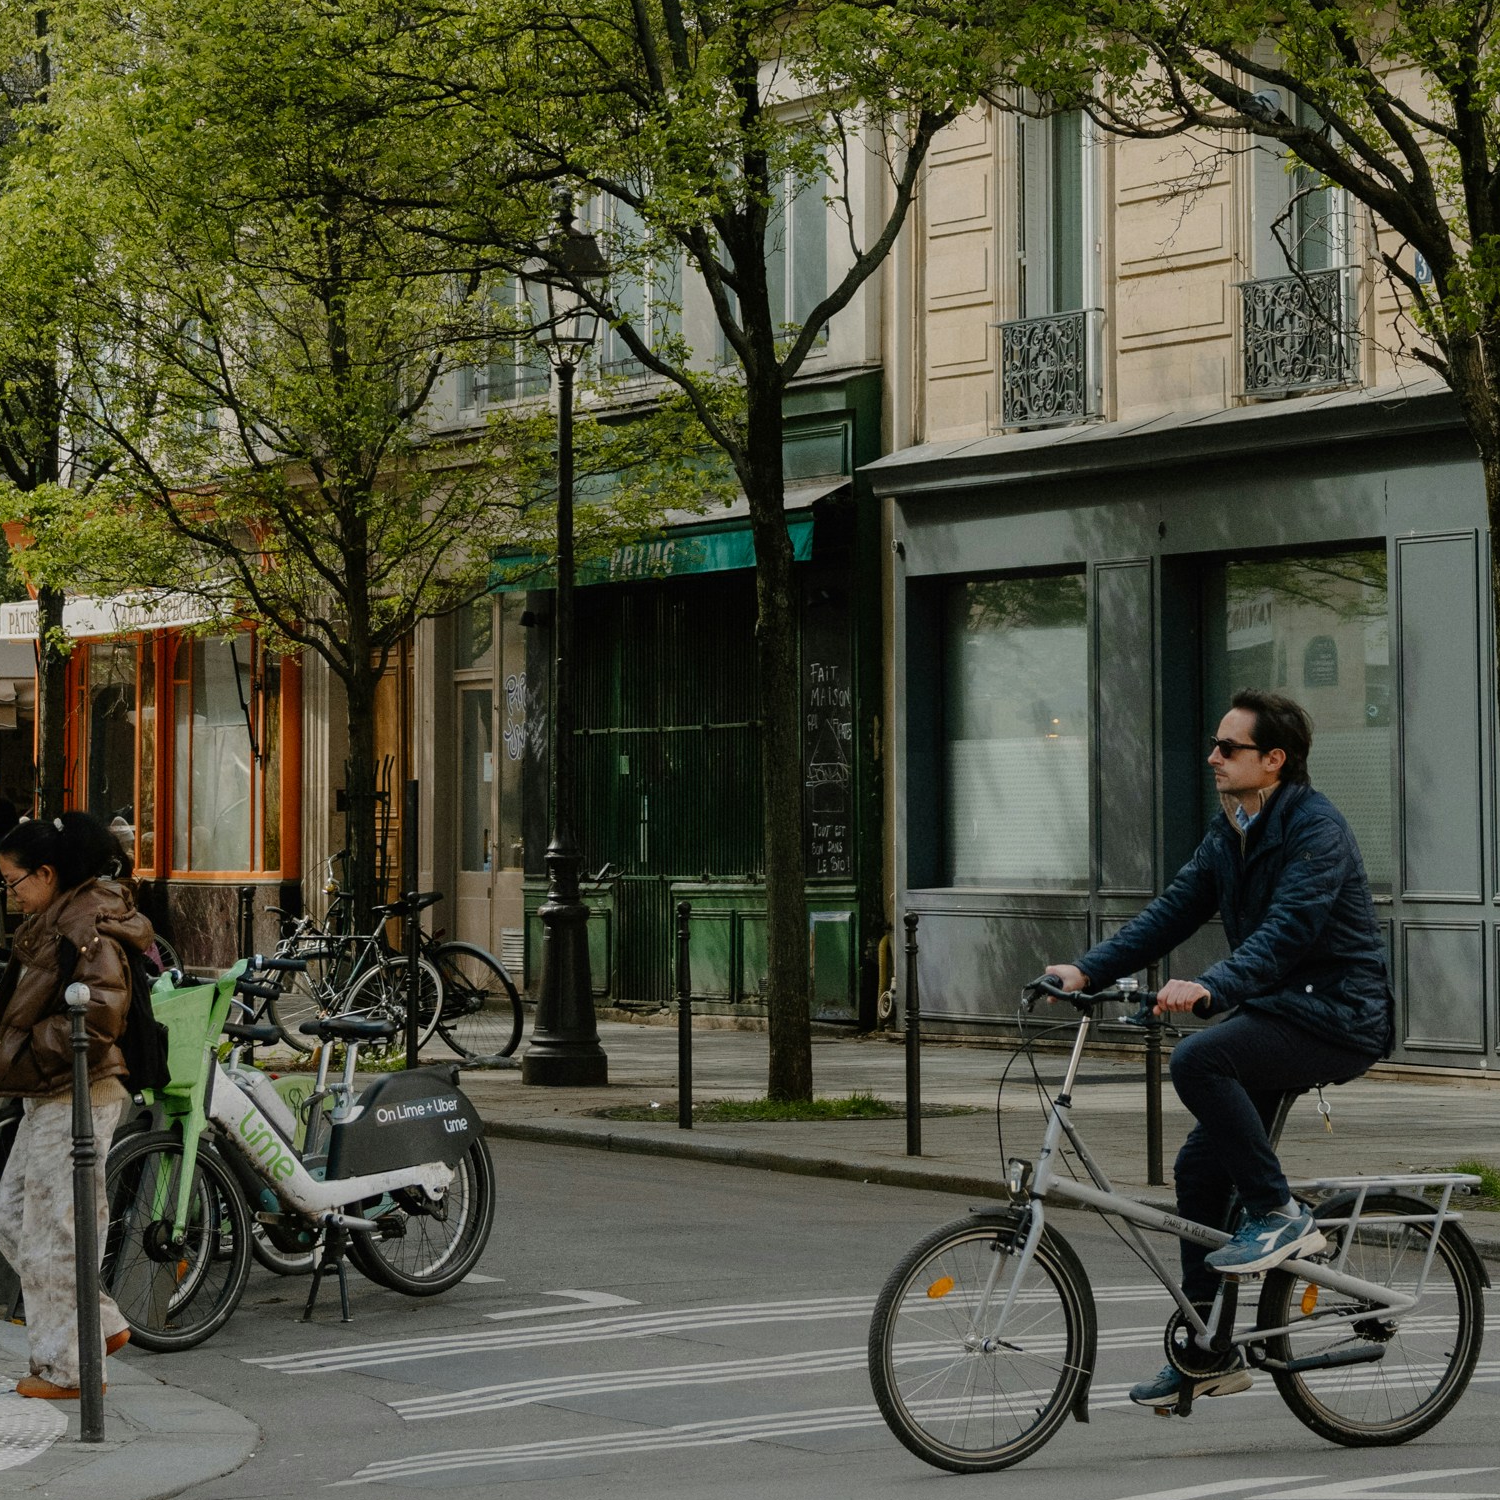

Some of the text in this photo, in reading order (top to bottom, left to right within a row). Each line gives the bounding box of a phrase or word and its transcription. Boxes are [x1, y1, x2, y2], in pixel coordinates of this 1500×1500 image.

[811, 822, 846, 838] TOUT EST
[817, 858, 827, 873] LE
[376, 1108, 397, 1123] On
[396, 1104, 426, 1120] Lime
[433, 1098, 458, 1113] Uber
[239, 1106, 295, 1181] Lime
